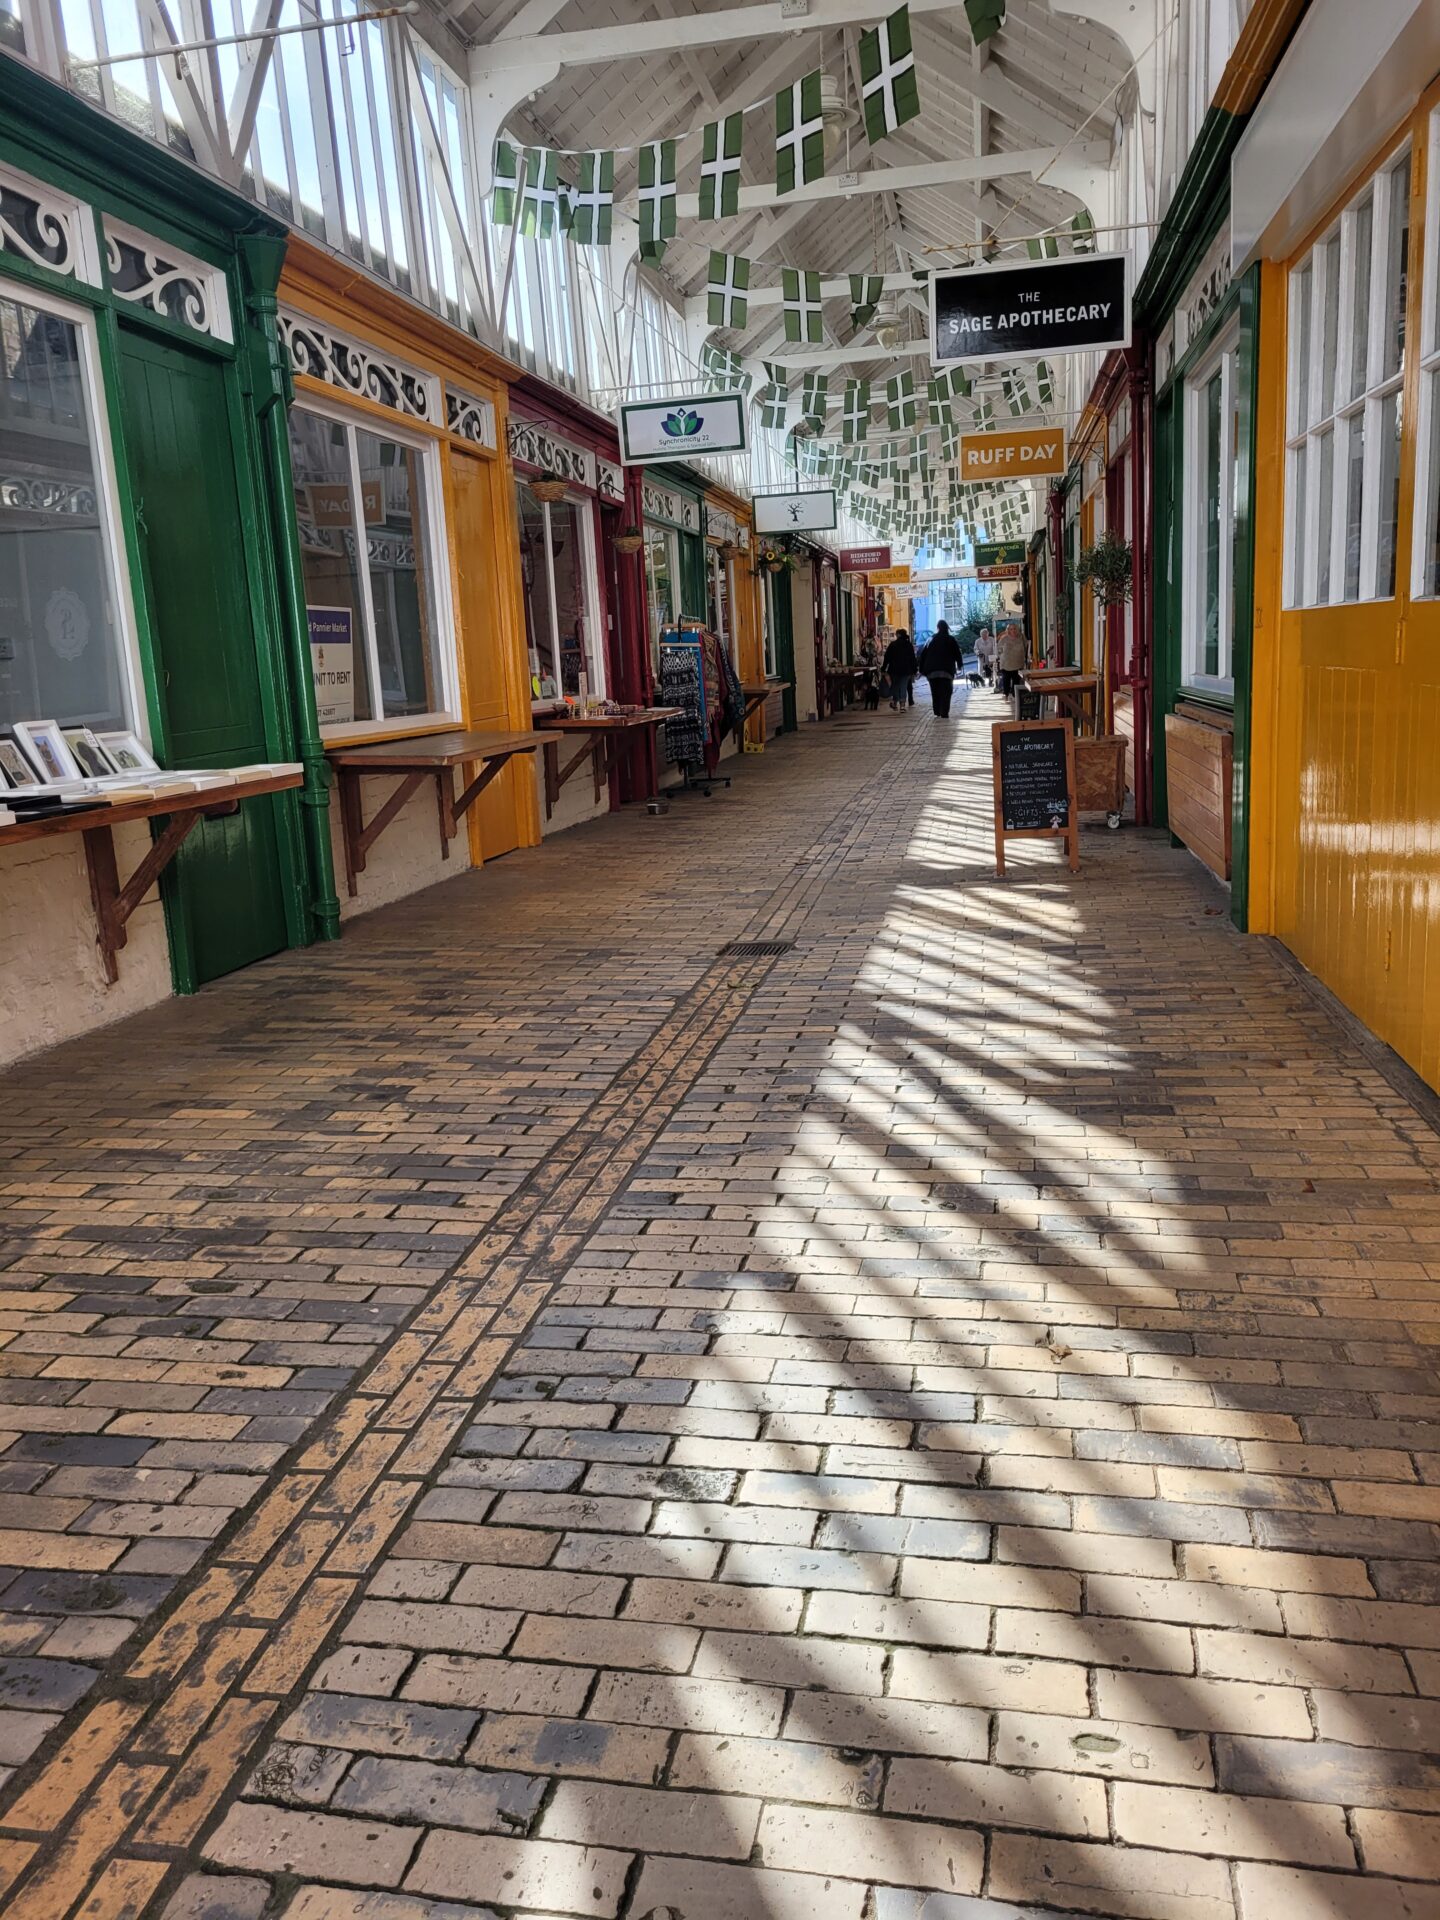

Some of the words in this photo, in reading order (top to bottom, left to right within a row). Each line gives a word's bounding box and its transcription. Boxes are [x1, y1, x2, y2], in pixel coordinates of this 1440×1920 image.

[1018, 291, 1041, 304] THE
[949, 315, 993, 335] SAGE
[997, 302, 1112, 329] APOTHECARY
[658, 436, 701, 445] Synchronicity
[967, 447, 1015, 466] RUFF
[1020, 443, 1058, 461] DAY
[850, 551, 882, 559] BIDEFORD
[992, 567, 1017, 575] SWEETS
[312, 622, 332, 633] Pannier
[327, 672, 336, 686] TO
[336, 671, 351, 685] RENT
[1006, 744, 1021, 752] SAGE
[1023, 743, 1054, 751] APOTHECARY
[1017, 808, 1038, 817] GIFTS
